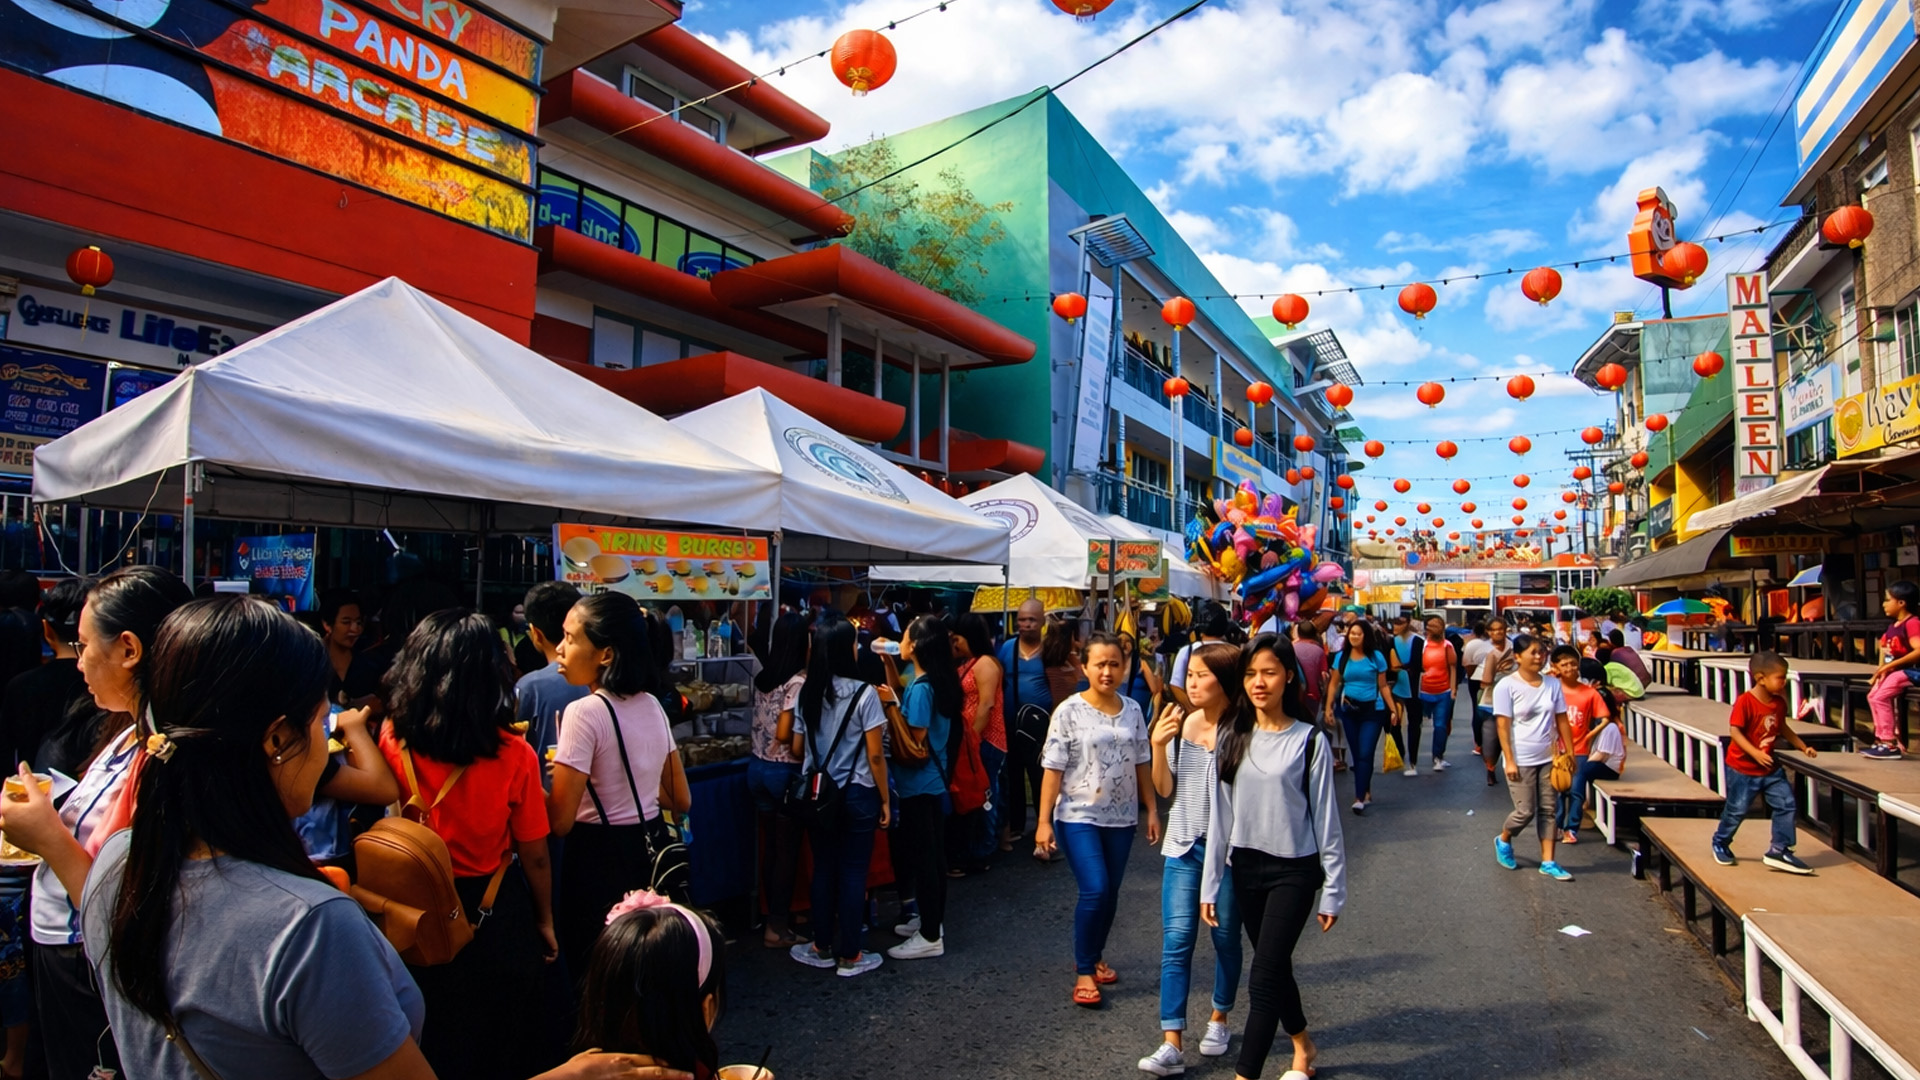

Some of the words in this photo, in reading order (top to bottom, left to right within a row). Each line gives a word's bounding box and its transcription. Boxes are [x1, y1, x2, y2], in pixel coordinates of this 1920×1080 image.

[267, 45, 501, 163] ARCADE
[319, 0, 468, 99] PANDA
[1734, 274, 1772, 476] MAILEEN
